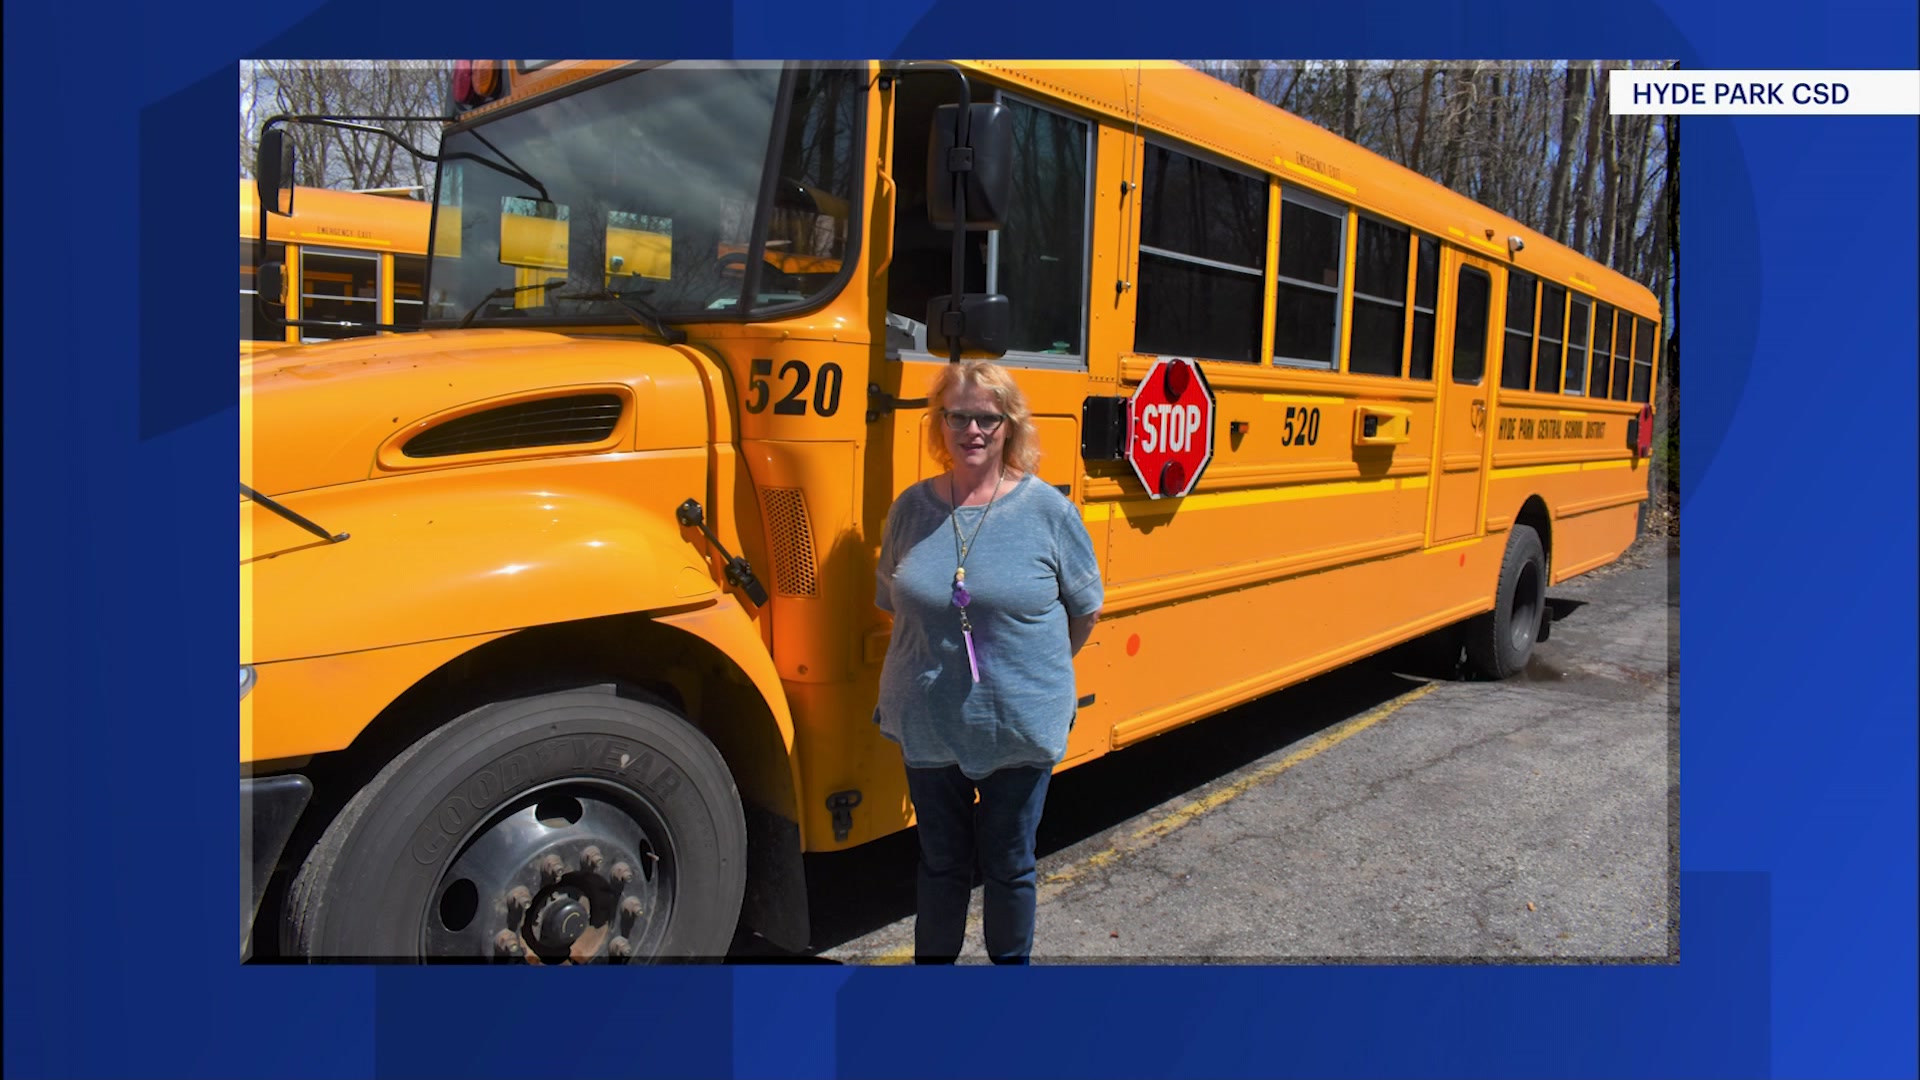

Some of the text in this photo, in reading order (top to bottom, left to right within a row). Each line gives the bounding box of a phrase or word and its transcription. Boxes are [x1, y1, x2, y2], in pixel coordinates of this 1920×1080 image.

[317, 226, 353, 237] EMERGENCY
[745, 358, 843, 418] 520
[1141, 404, 1201, 453] STOP
[1281, 406, 1321, 447] 520
[1498, 417, 1607, 440] HYDE PARK CENTRAL SCHOOL DISTRICT
